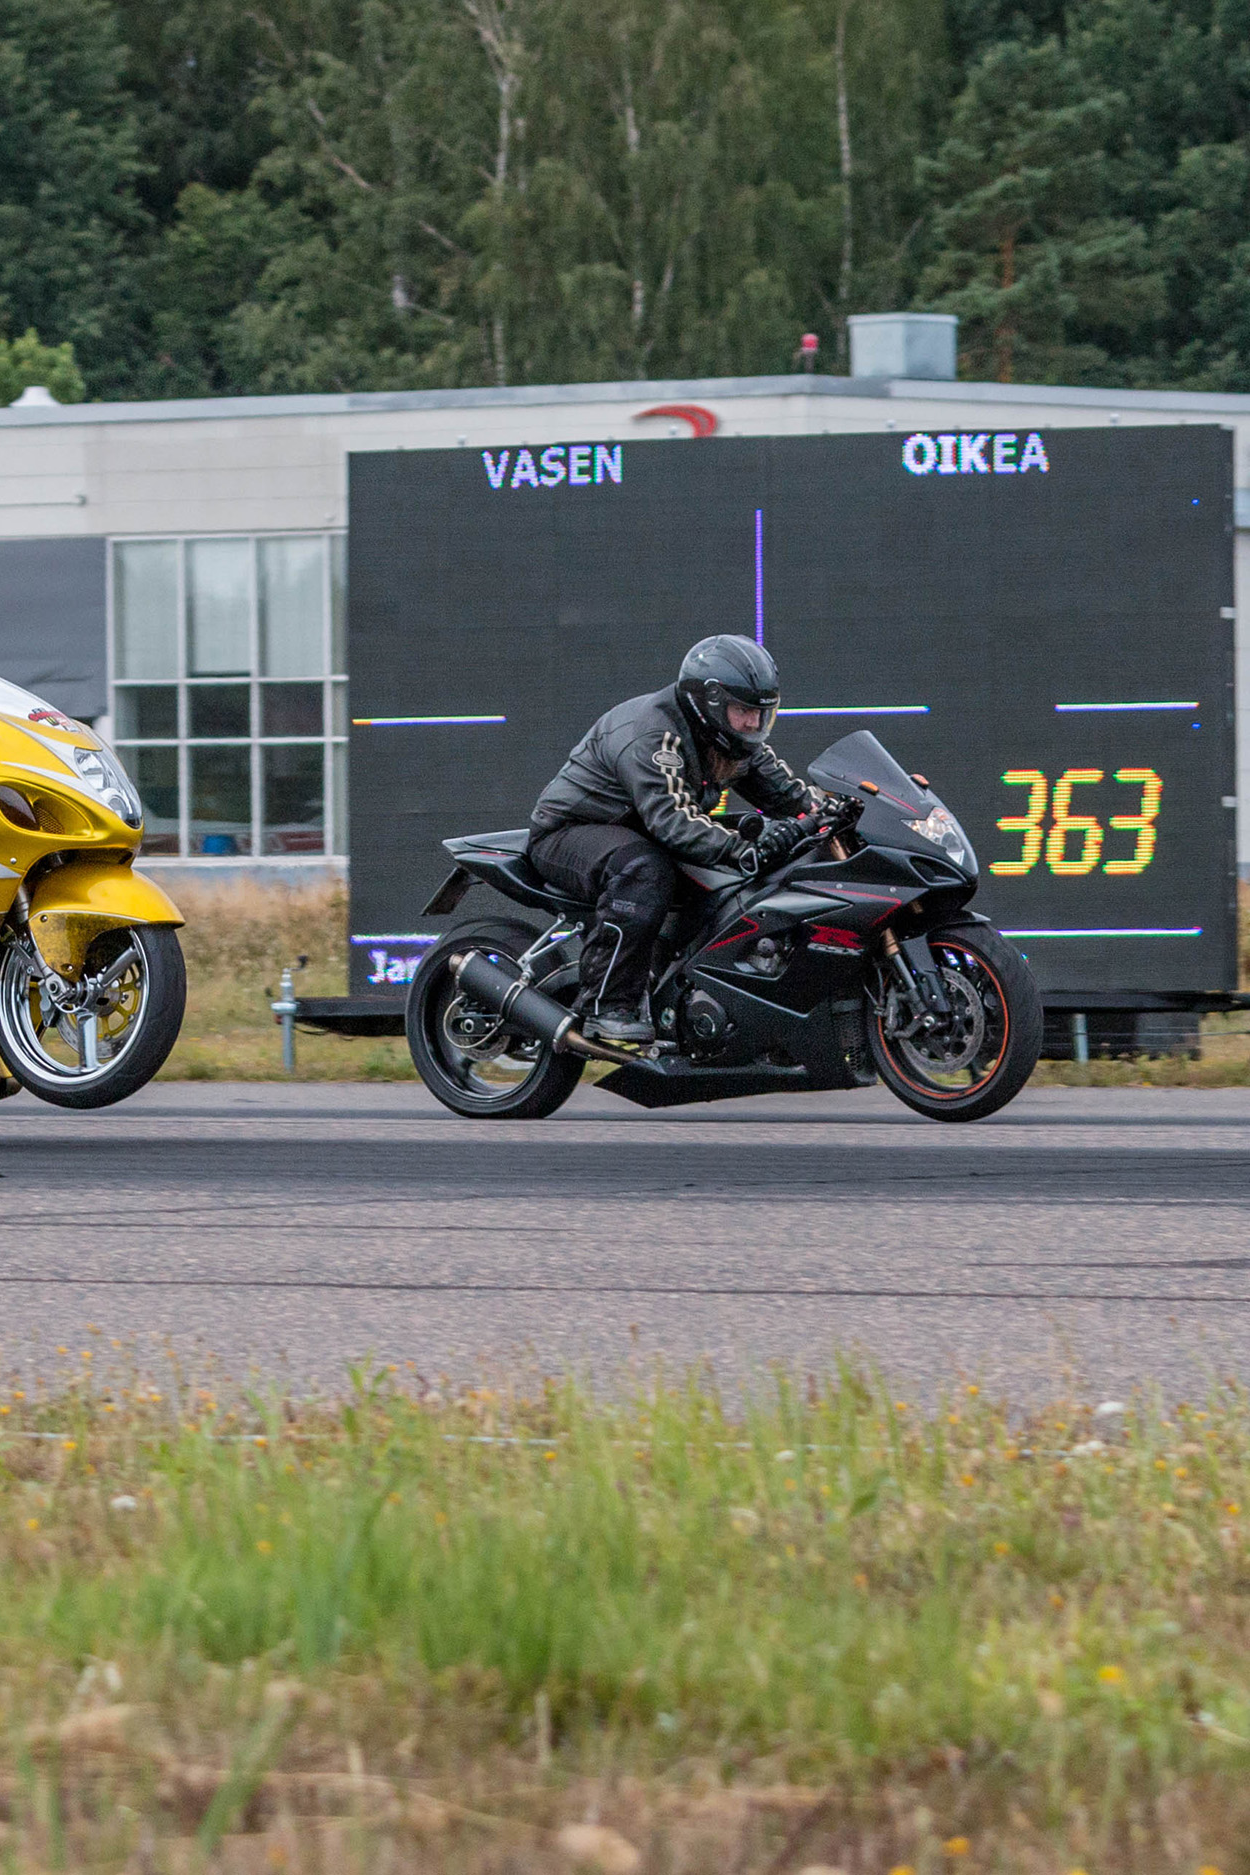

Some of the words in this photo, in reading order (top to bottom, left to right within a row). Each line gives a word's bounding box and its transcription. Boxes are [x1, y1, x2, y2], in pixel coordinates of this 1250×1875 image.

[481, 444, 623, 490] VASEN
[901, 432, 1050, 476] OIKEA
[989, 767, 1164, 876] 363
